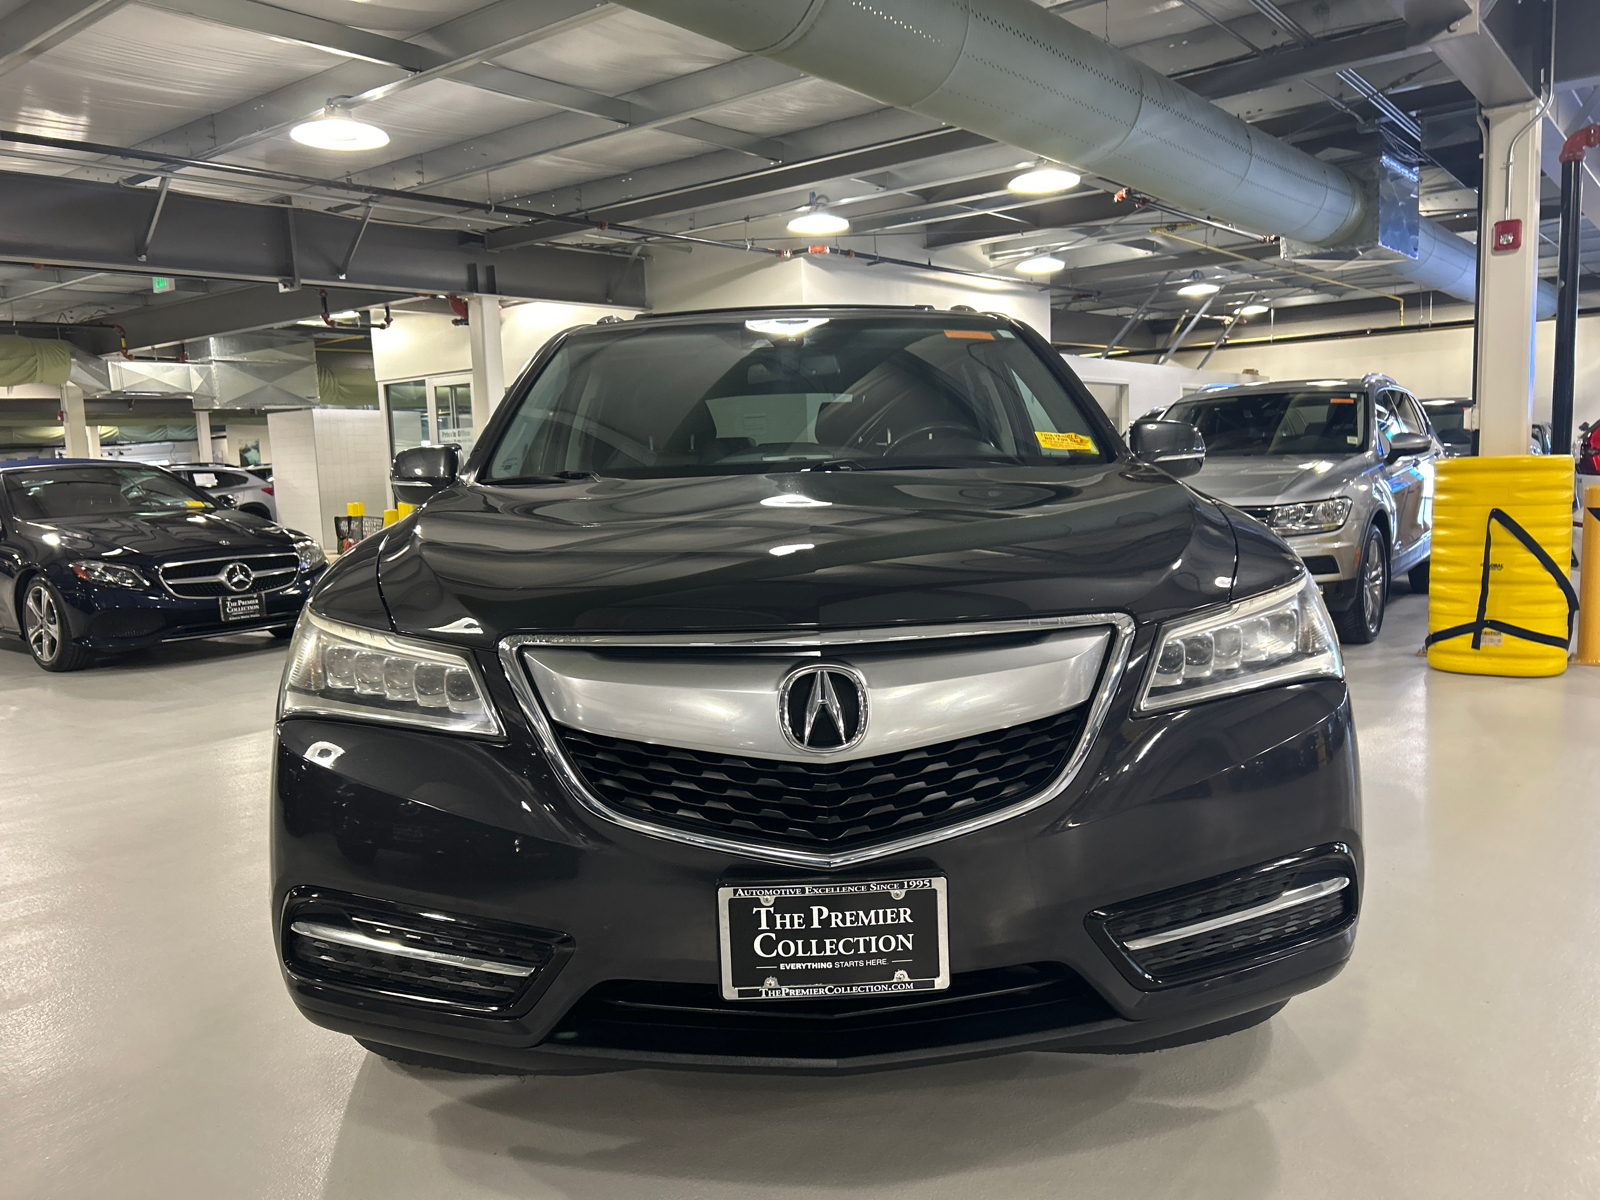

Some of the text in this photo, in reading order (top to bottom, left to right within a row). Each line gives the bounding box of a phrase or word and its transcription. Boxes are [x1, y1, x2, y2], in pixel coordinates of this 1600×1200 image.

[226, 605, 260, 613] COLLECTION
[735, 879, 931, 897] AUTOMOTIVE EXCELLENCE SINCE 1995
[752, 905, 914, 930] THE PREMIER
[753, 932, 914, 958] COLLECTION
[779, 962, 833, 970] EVERYTHING
[834, 960, 865, 968] STARTS
